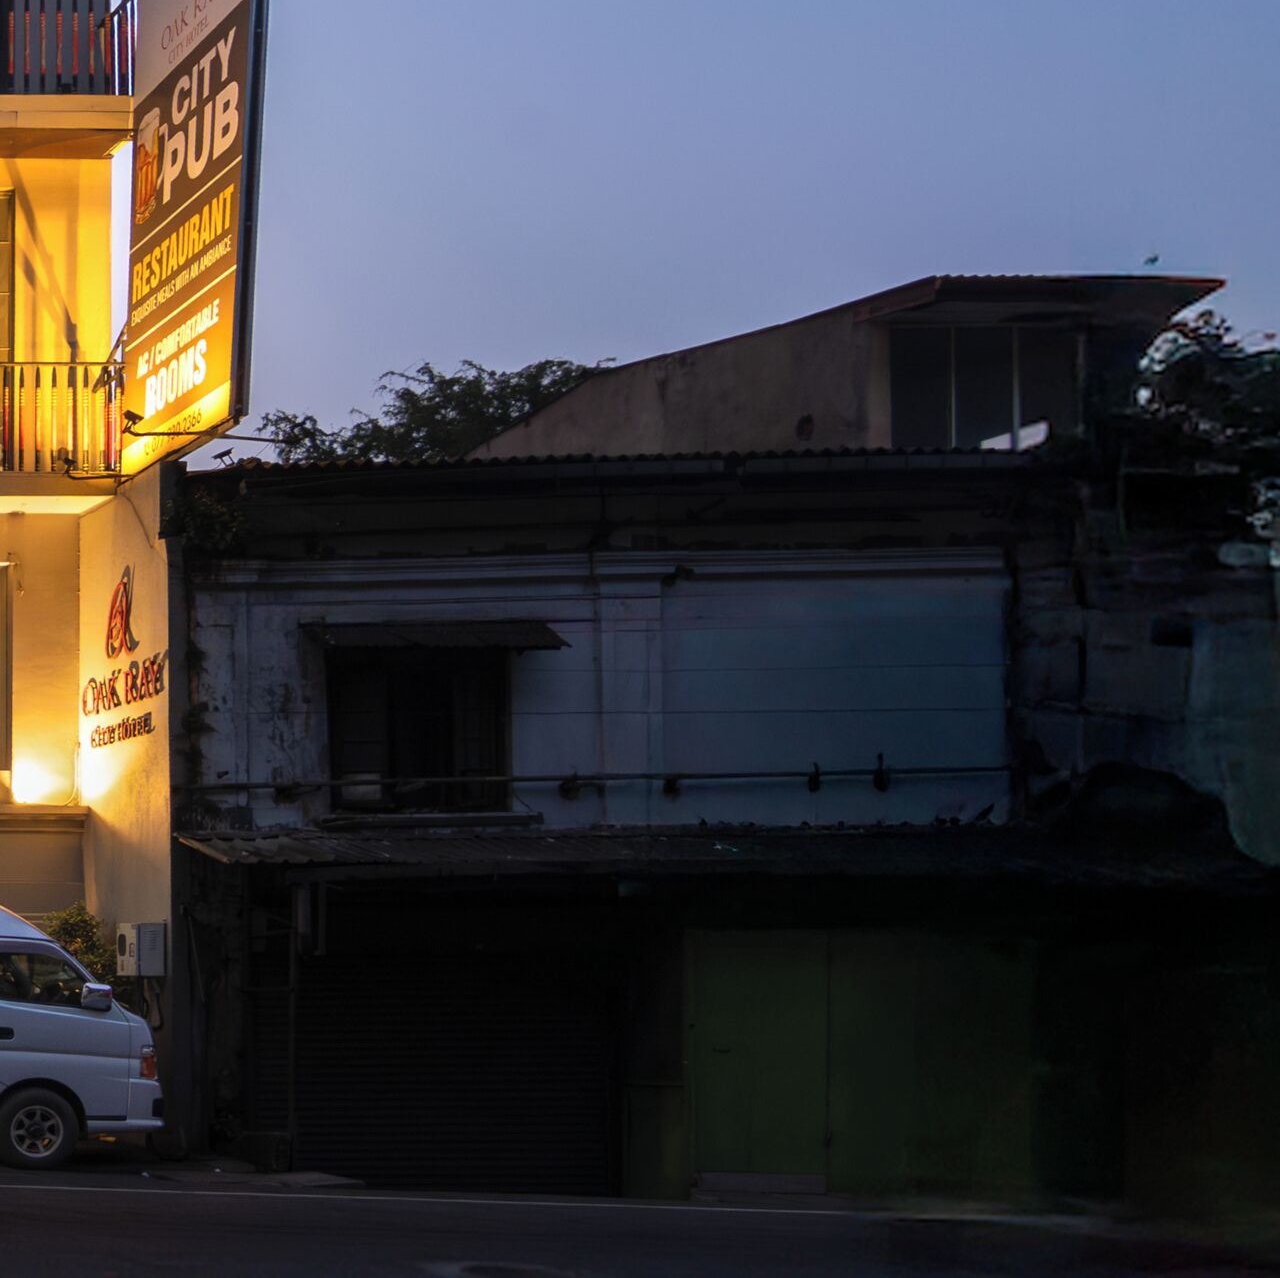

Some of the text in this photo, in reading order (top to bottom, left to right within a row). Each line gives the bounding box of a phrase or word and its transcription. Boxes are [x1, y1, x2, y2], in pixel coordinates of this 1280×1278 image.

[161, 5, 188, 50] OAK
[168, 14, 209, 64] CITY HOTEL
[172, 26, 236, 125] CITY
[163, 81, 239, 205] PUB
[131, 234, 232, 327] EXQUISITE MEALS WITH AN AMBIANCE
[132, 183, 234, 304] RESTAURANT
[136, 351, 149, 380] AC
[155, 298, 220, 365] COMFORTABLE
[144, 338, 207, 420] ROOMS
[183, 408, 201, 435] 2366
[82, 658, 163, 716] OAK RAY
[118, 715, 151, 741] HOTEL
